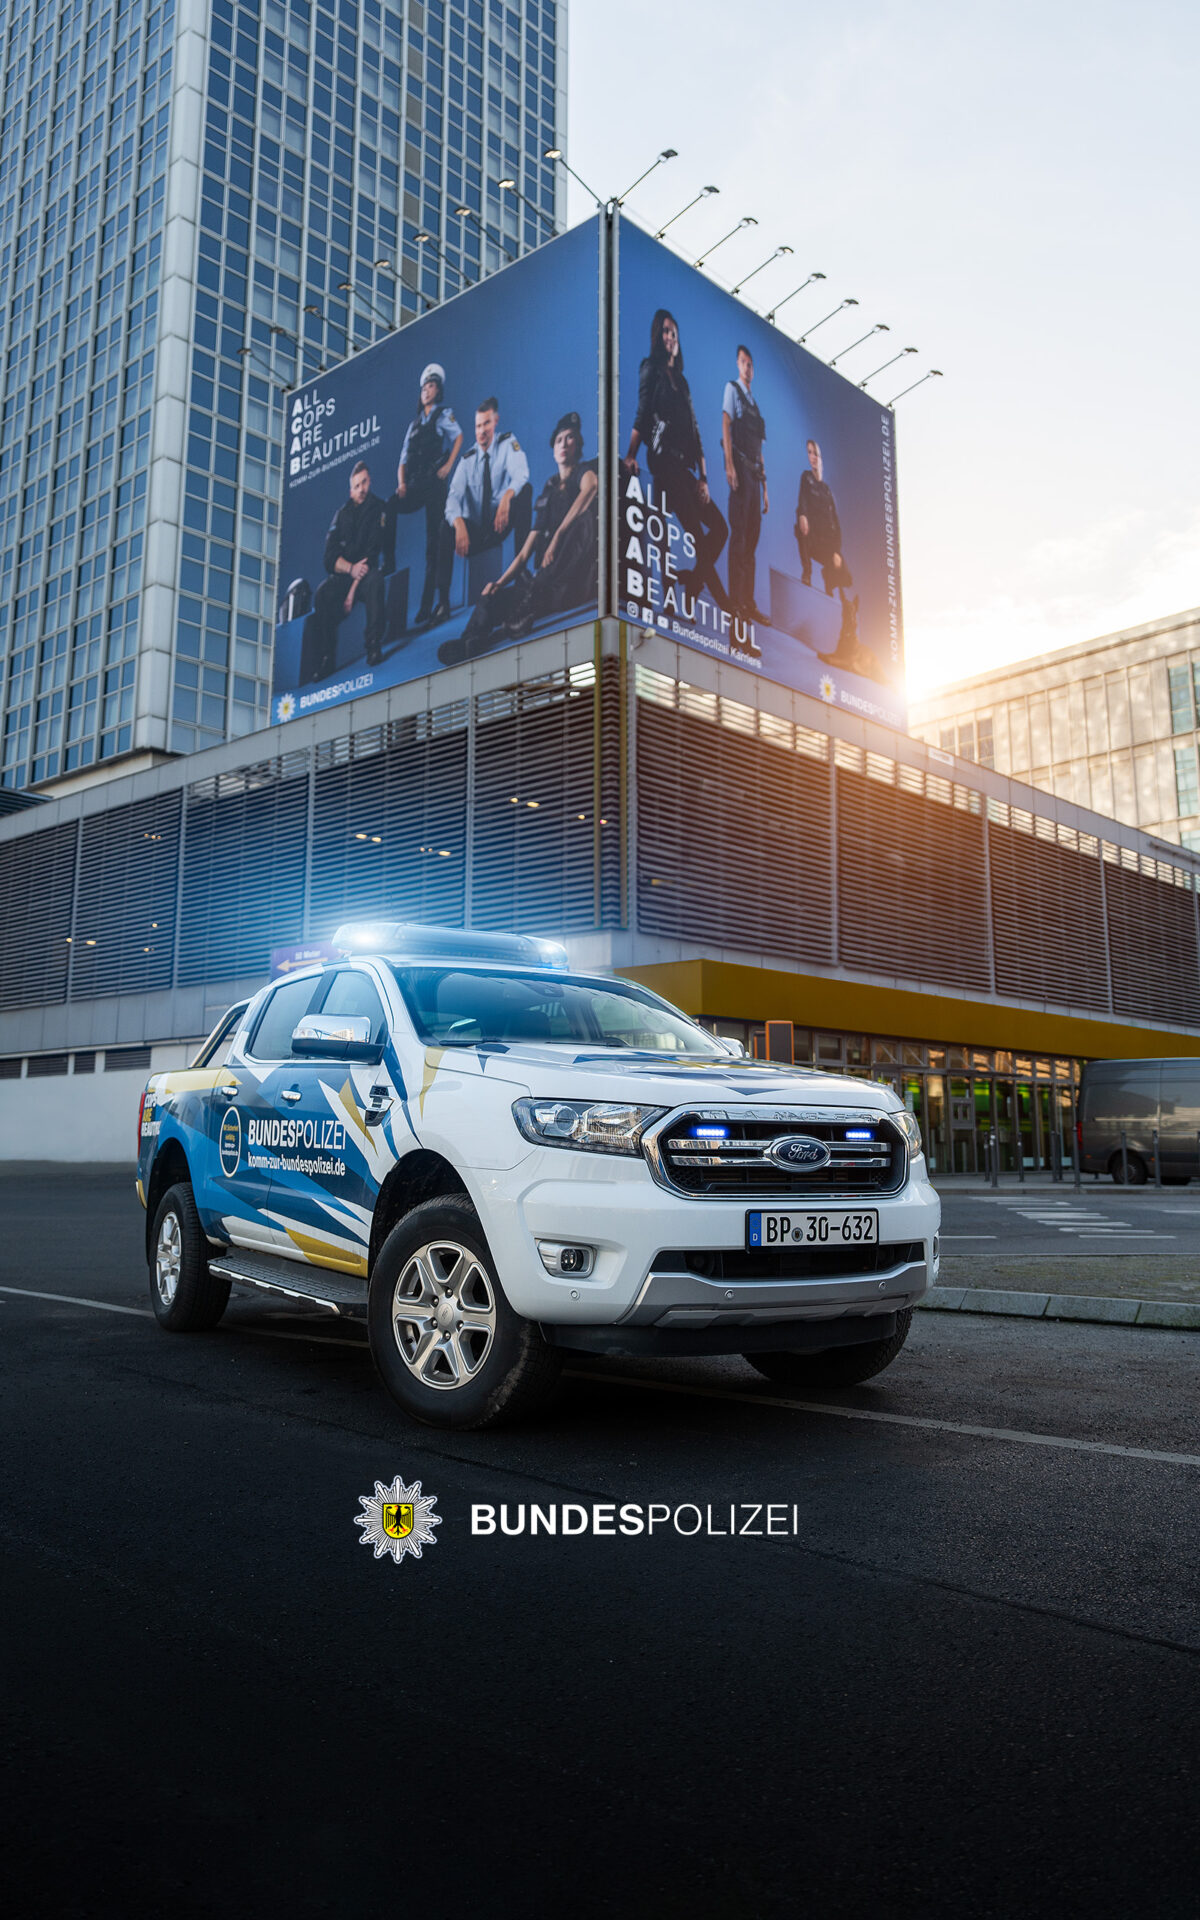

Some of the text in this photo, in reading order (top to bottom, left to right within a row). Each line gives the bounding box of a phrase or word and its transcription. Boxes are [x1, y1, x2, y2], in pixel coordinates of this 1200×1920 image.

[291, 397, 336, 435] COPS
[292, 389, 321, 417] ALL
[289, 415, 381, 476] BEAUTIFUL
[290, 423, 323, 455] ARE
[625, 475, 673, 518] ALL
[626, 505, 696, 558] COPS
[625, 535, 678, 580] ARE
[627, 567, 761, 650] BEAUTIFUL
[300, 673, 374, 708] BUNDESPOLIZEI
[248, 1119, 346, 1150] BUNDESPOLIZEI
[787, 1143, 819, 1161] Ford
[247, 1151, 346, 1177] komm-zur-bundespolizei.de
[767, 1215, 873, 1242] BP 30-632
